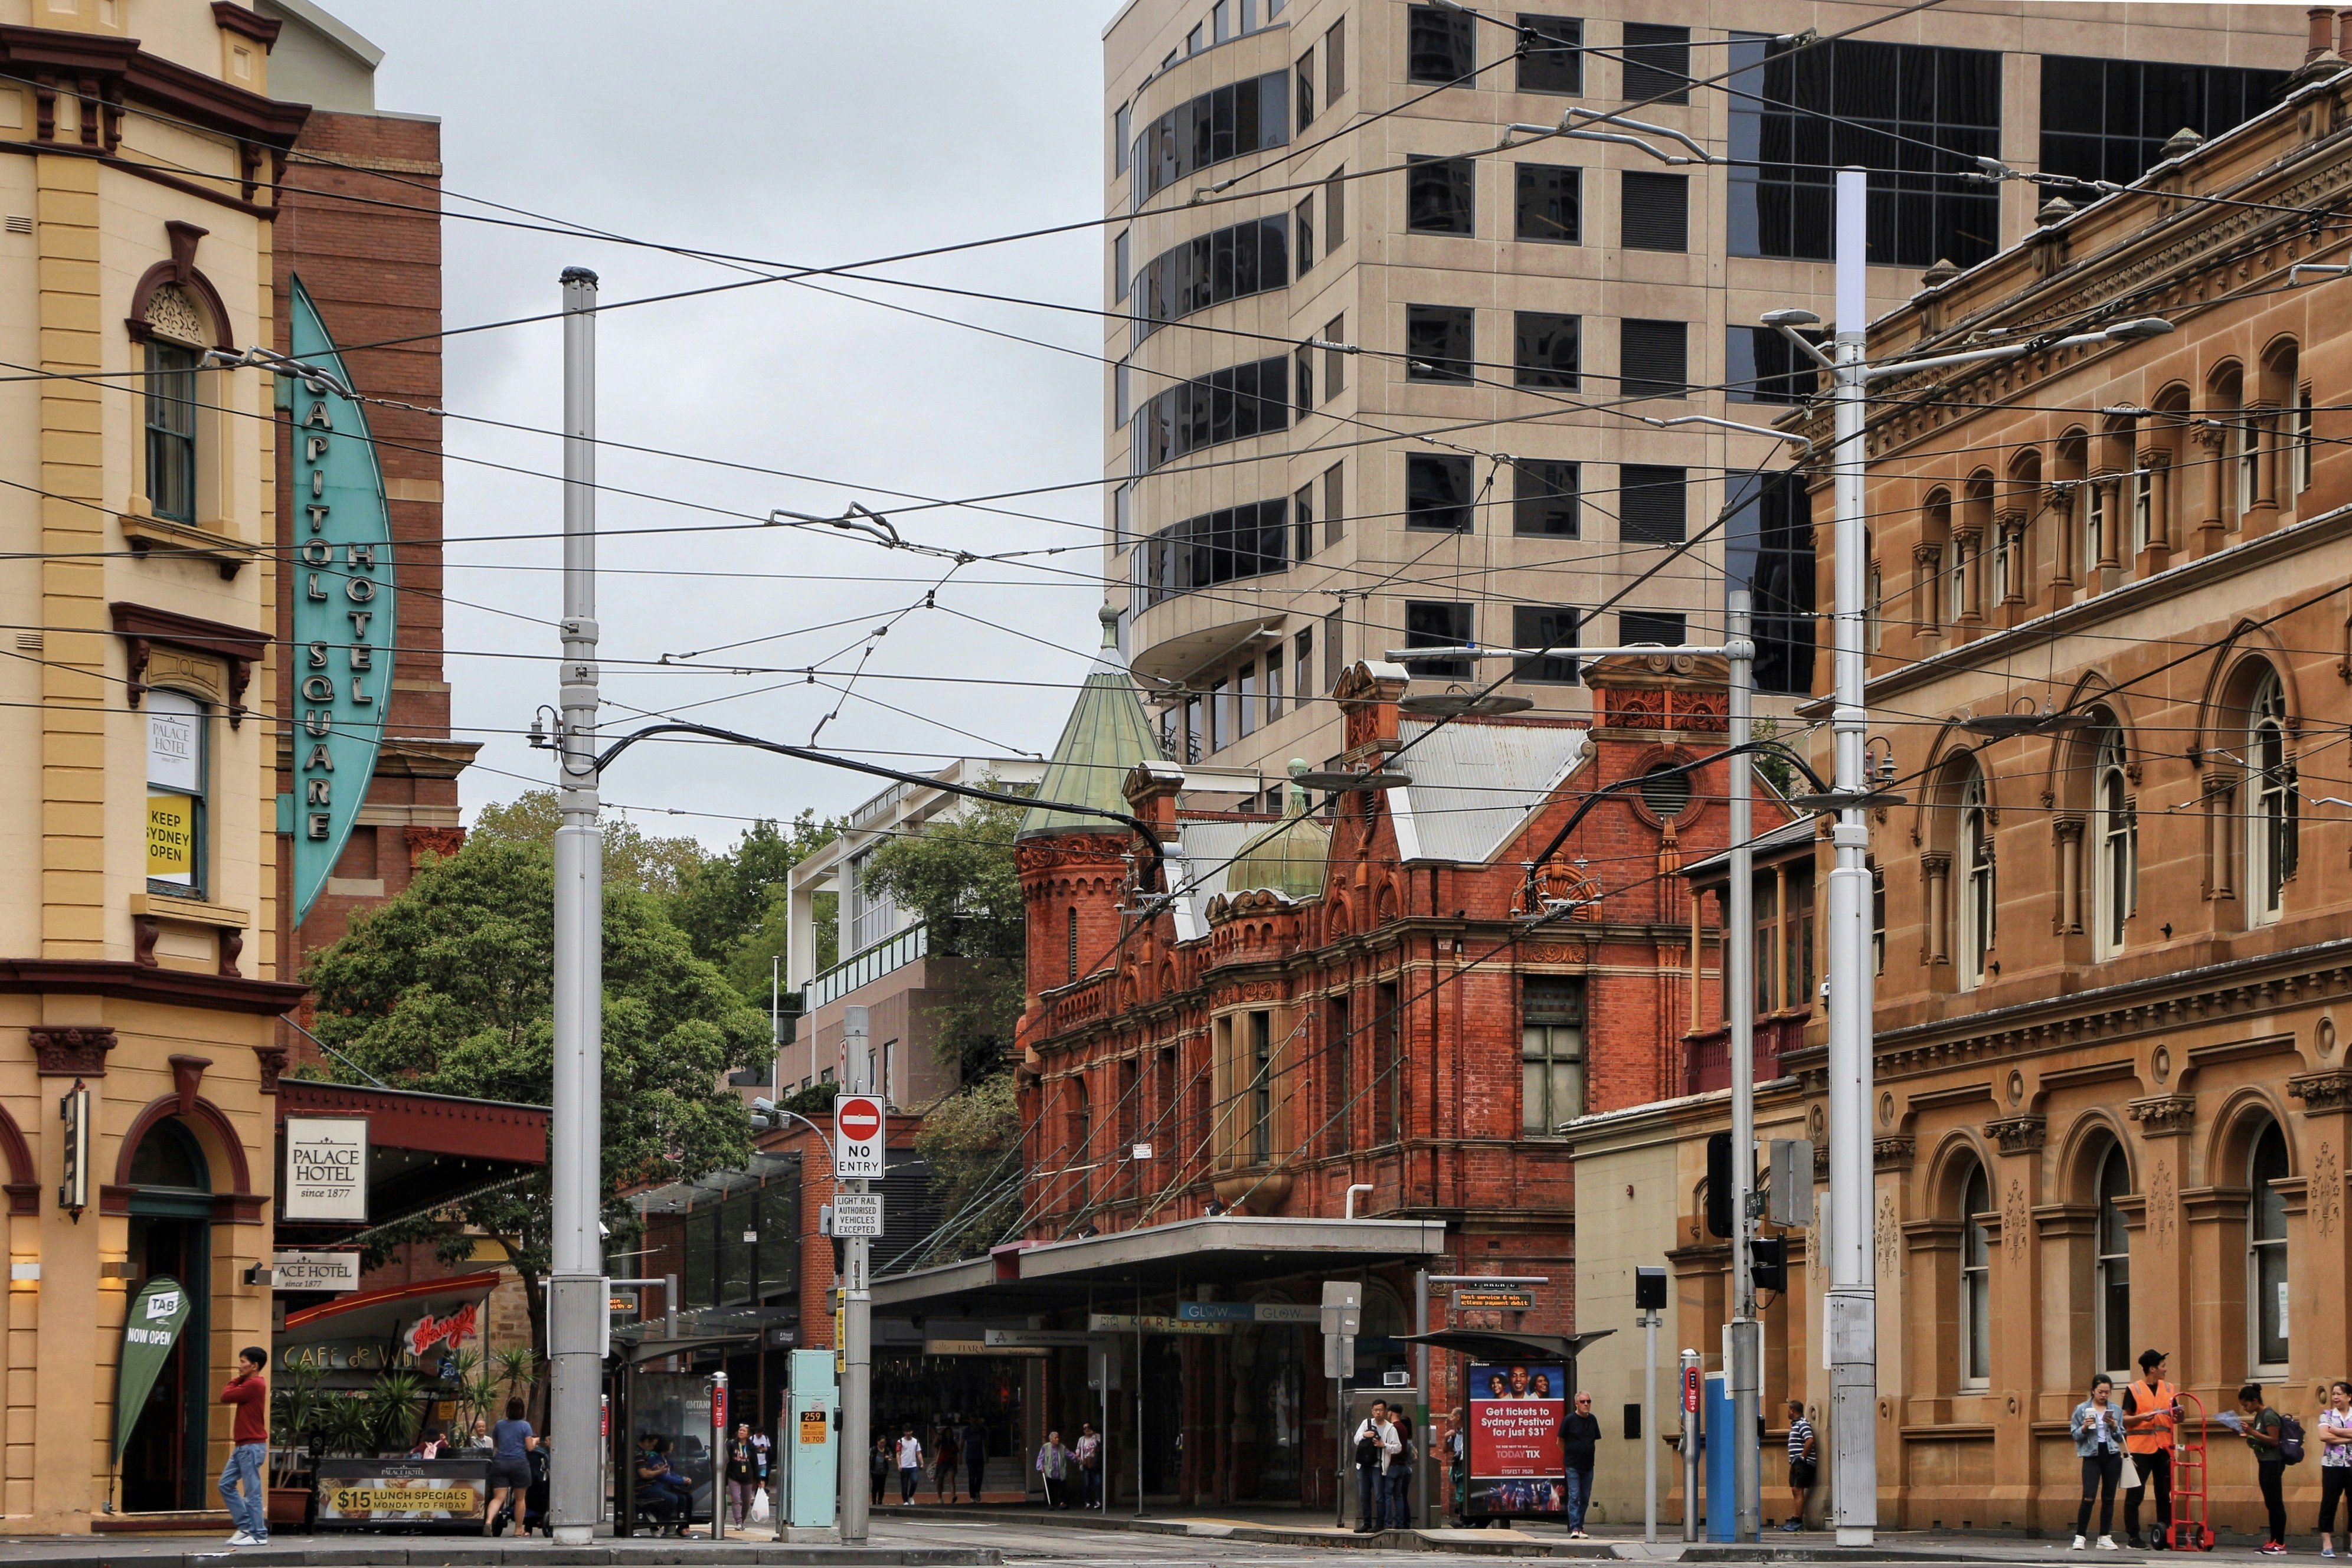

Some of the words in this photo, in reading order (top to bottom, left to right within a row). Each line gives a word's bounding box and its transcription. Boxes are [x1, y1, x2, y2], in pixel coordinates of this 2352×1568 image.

[346, 542, 377, 703] HOTEL
[153, 723, 189, 742] PALACE
[155, 739, 188, 755] HOTEL
[302, 641, 334, 840] SQUARE
[152, 810, 181, 827] KEEP
[150, 844, 182, 862] OPEN
[293, 1149, 359, 1165] PALACE
[849, 1145, 870, 1158] NO
[839, 1161, 879, 1171] ENTRY
[296, 1166, 355, 1181] HOTEL
[301, 1188, 325, 1197] since
[328, 1189, 351, 1198] 1877
[838, 1197, 857, 1205] LIGHT
[861, 1197, 877, 1205] RAIL
[840, 1216, 875, 1225] VEHICLES
[839, 1226, 875, 1234] EXCEPTED
[309, 1266, 352, 1278] HOTEL
[152, 1298, 174, 1311] TAB
[413, 1303, 477, 1354] Harry's
[127, 1327, 149, 1343] NOW
[149, 1330, 172, 1346] OPEN
[349, 1346, 369, 1367] de
[804, 1412, 820, 1421] 259
[1486, 1407, 1504, 1416] Get
[1506, 1407, 1538, 1416] tickets
[1540, 1407, 1550, 1416] to
[1481, 1417, 1516, 1428] Sydney
[1518, 1417, 1554, 1426] Festival
[1493, 1428, 1506, 1436] for
[1508, 1428, 1526, 1438] just
[337, 1490, 371, 1509] $15
[374, 1491, 412, 1500] LUNCH
[414, 1491, 467, 1500] SPECIALS
